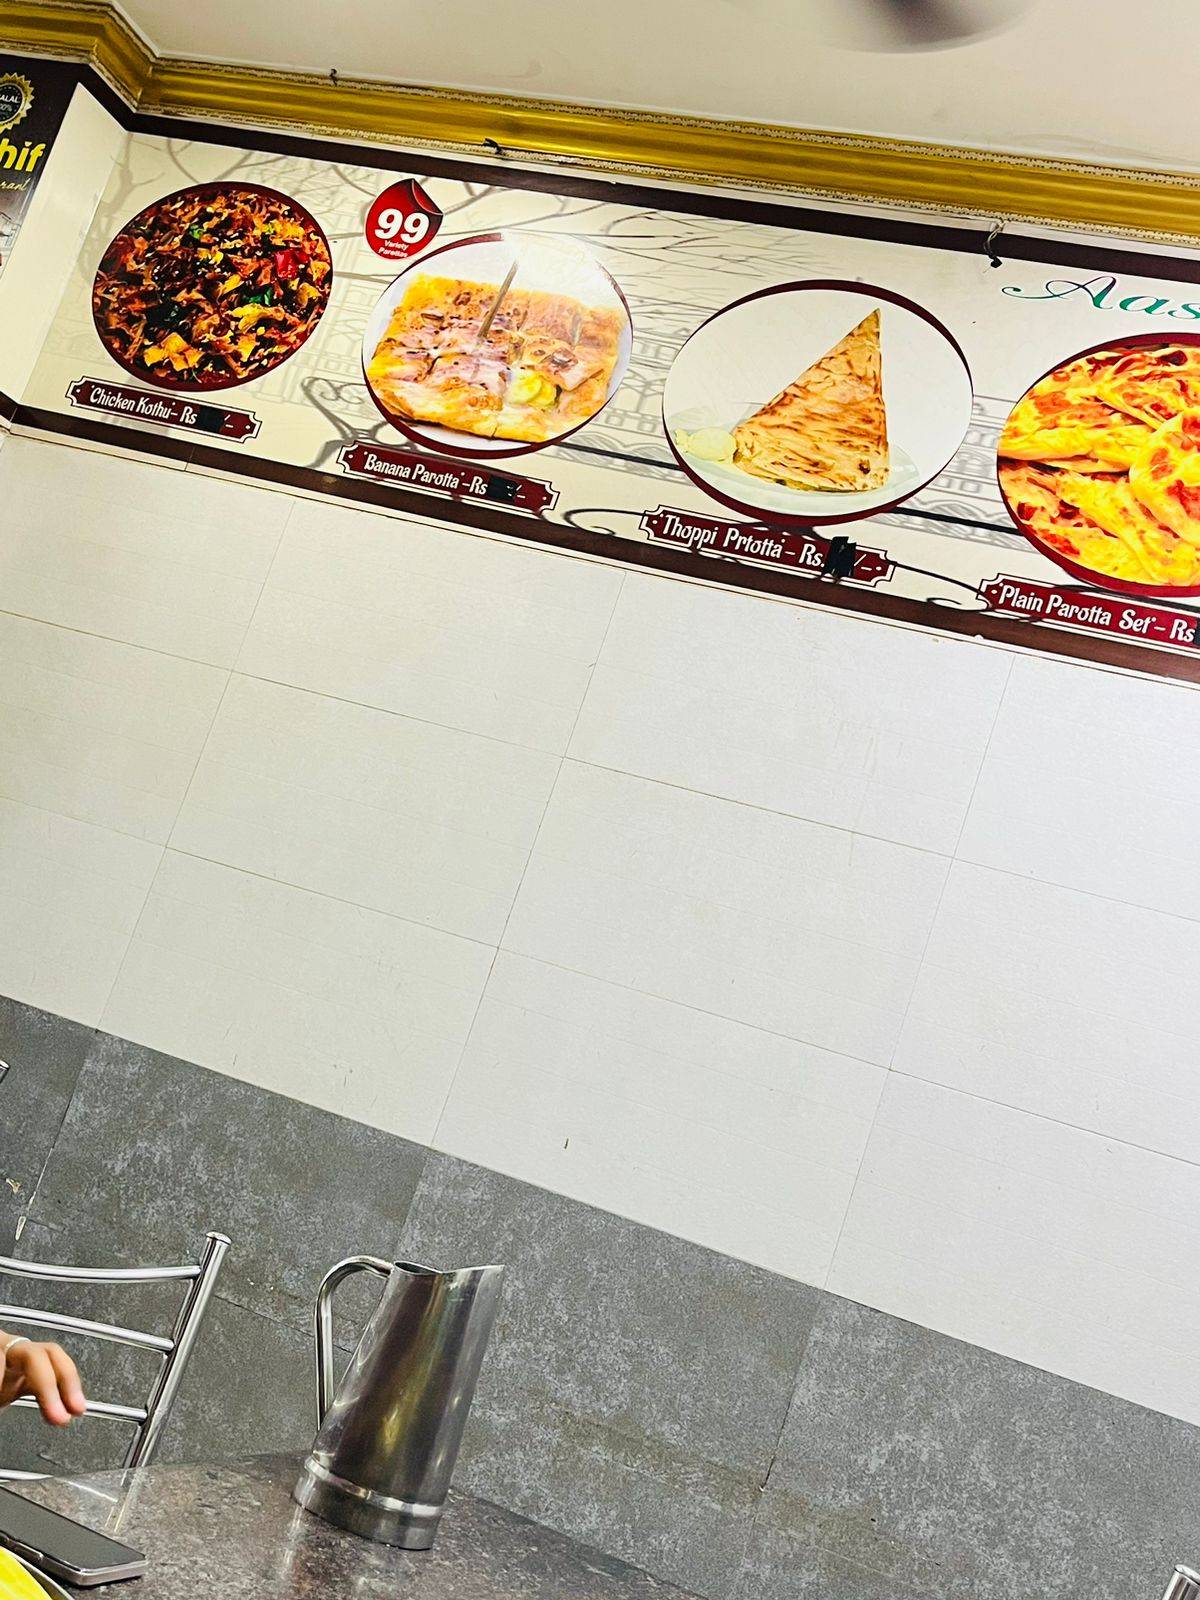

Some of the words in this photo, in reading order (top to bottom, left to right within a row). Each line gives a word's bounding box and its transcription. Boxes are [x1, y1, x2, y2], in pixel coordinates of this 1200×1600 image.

[0, 94, 20, 104] ALAL
[374, 208, 429, 244] 99
[1045, 594, 1112, 626] Parotta
